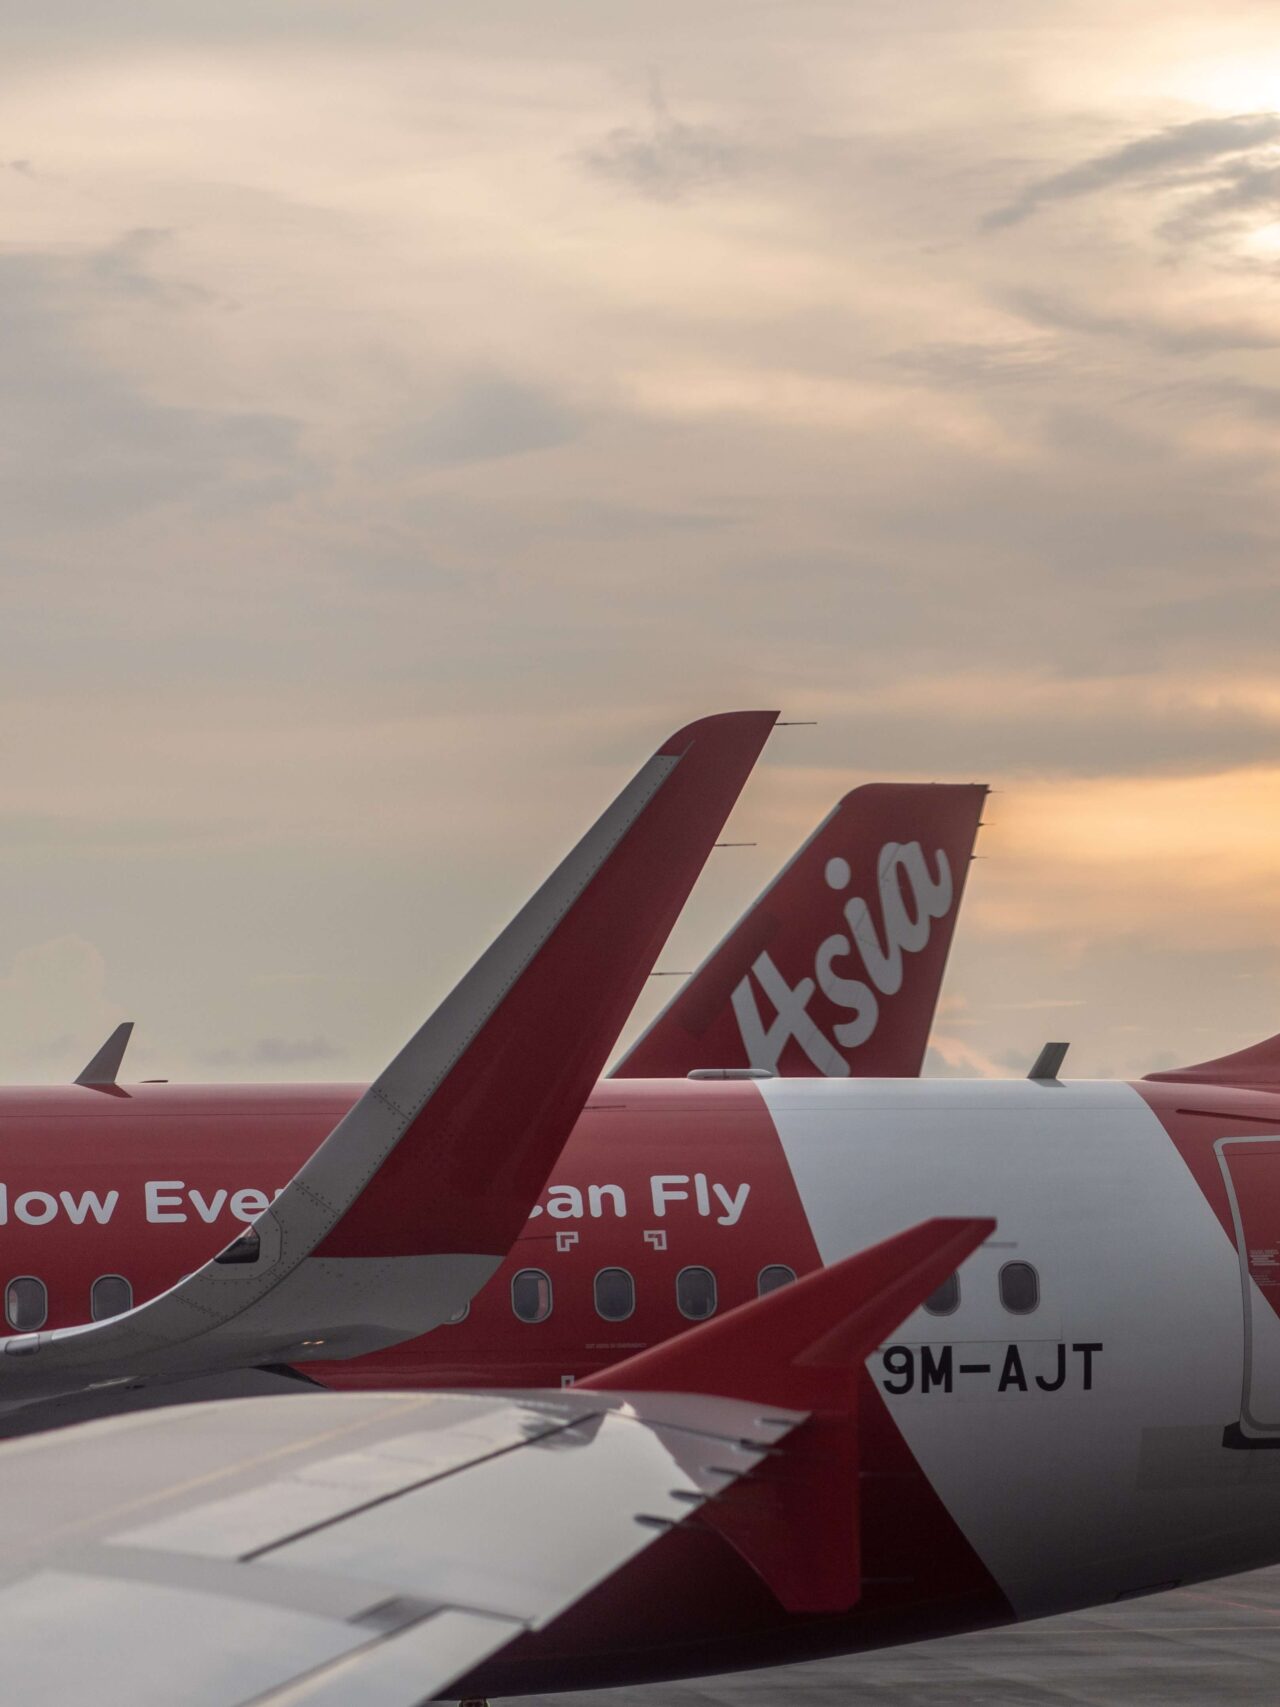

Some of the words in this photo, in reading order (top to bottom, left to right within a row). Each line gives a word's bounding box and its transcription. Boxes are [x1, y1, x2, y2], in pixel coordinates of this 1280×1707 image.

[731, 841, 953, 1077] Asia
[0, 1182, 119, 1226] ow
[145, 1180, 284, 1224] Eve
[528, 1184, 627, 1219] an
[650, 1173, 750, 1226] Fly
[883, 1343, 1103, 1394] 9M-AJT
